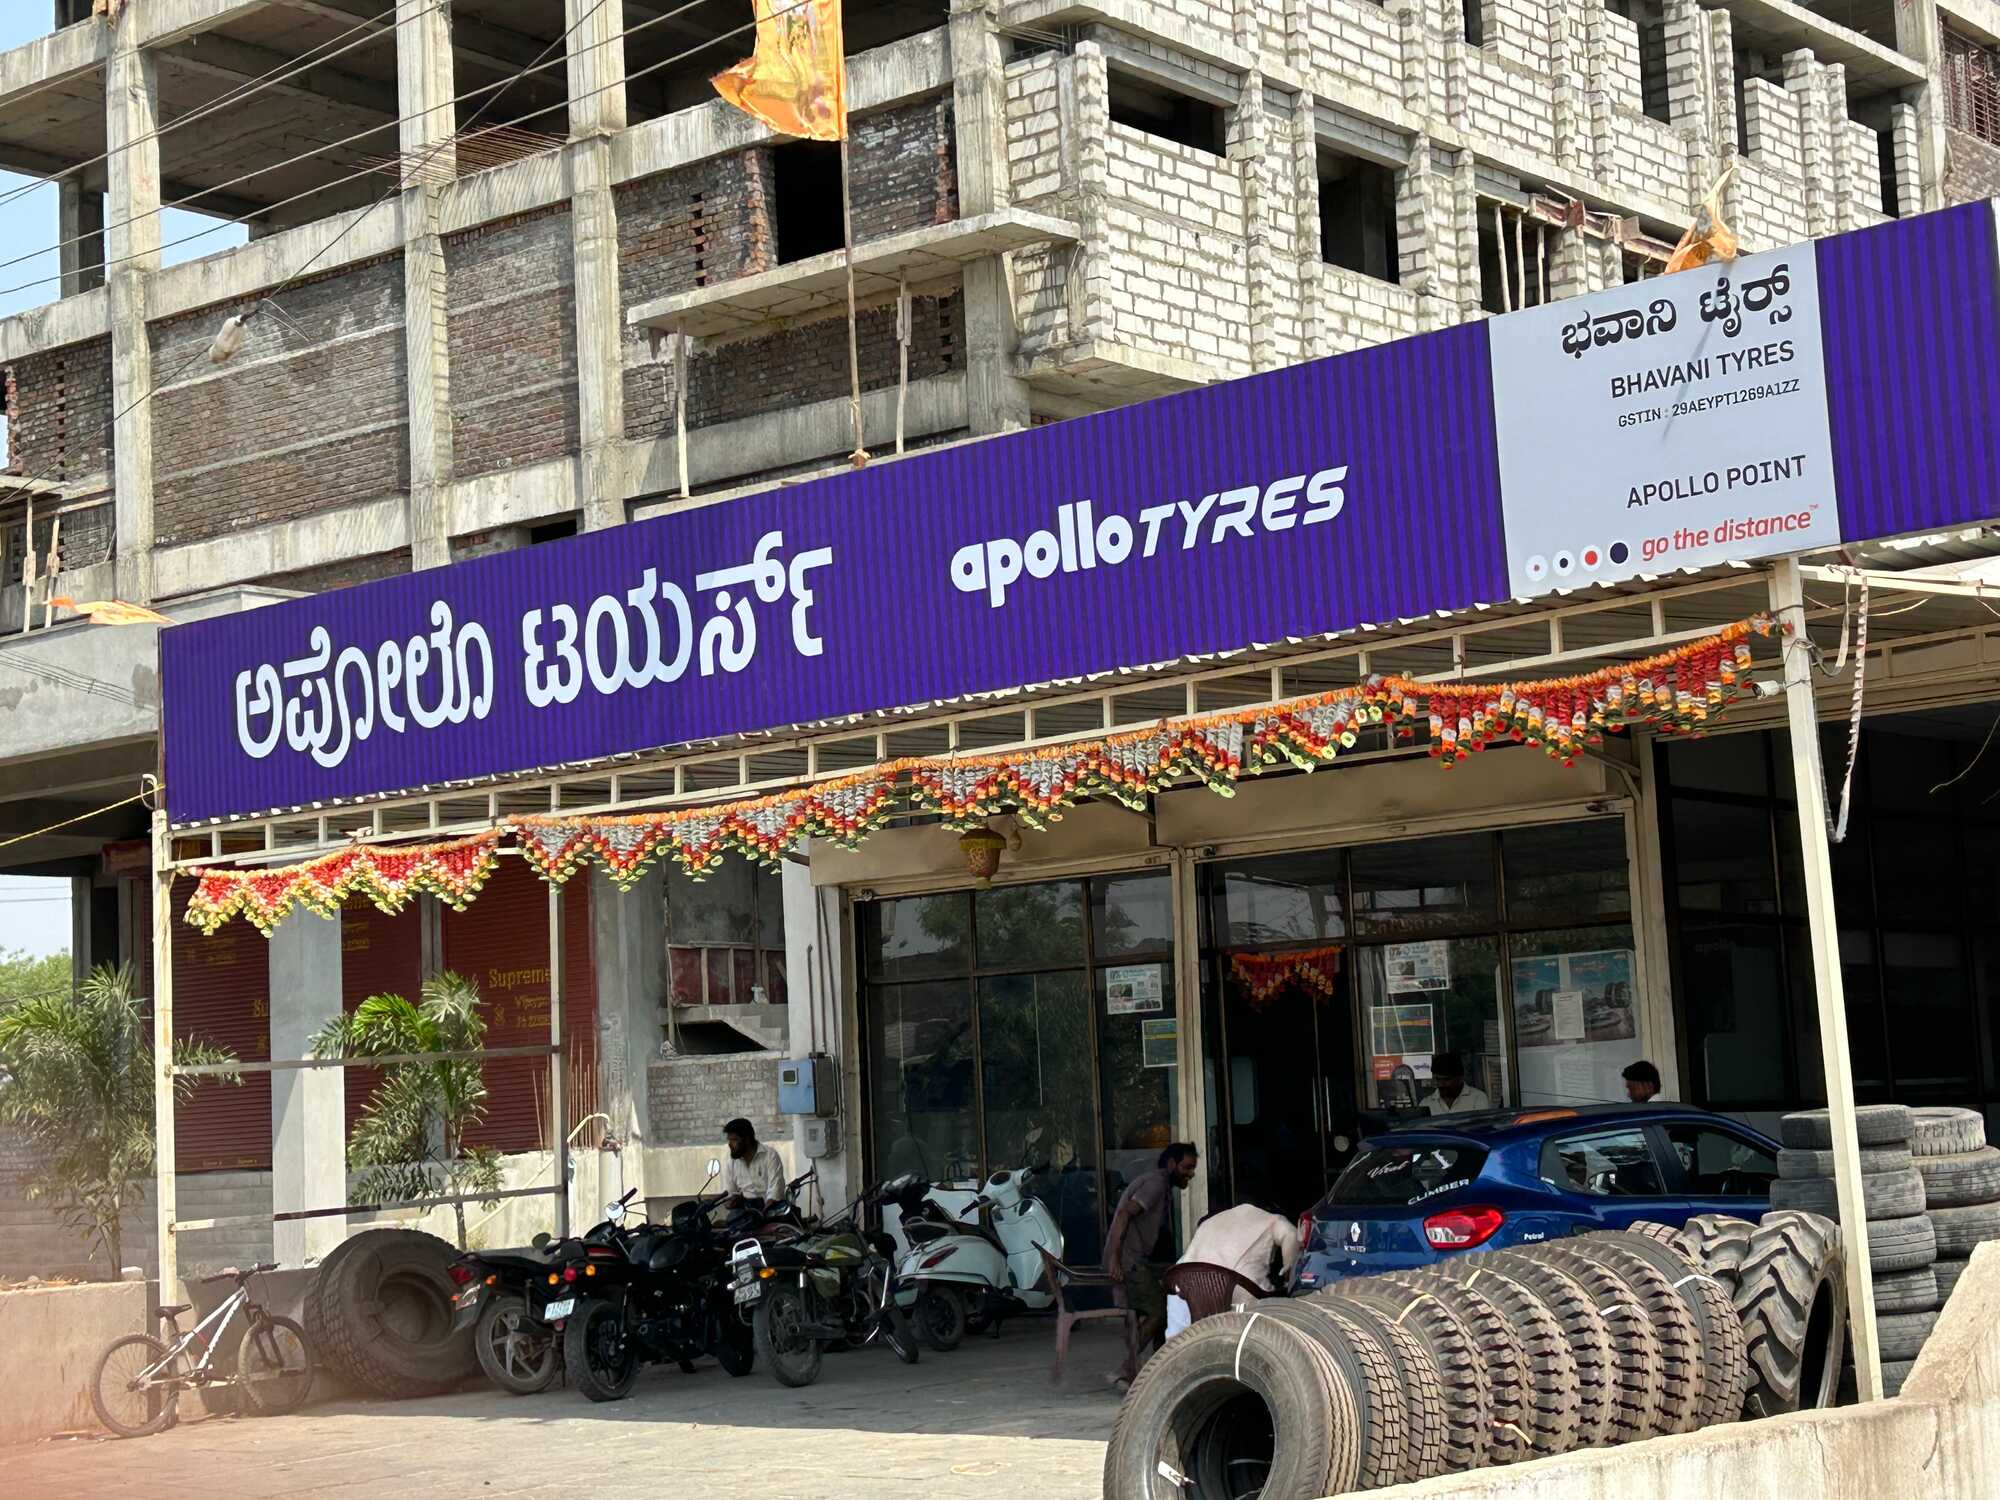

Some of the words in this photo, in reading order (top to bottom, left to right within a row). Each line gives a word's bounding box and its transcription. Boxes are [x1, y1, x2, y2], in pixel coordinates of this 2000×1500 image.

[1561, 299, 1677, 359] ಭವಾನಿ
[1611, 358, 1710, 399] BHAVANI
[1716, 340, 1795, 375] TYRES
[1618, 407, 1661, 428] GSTIN
[1671, 378, 1801, 418] 29AEYPT1269A1ZZ
[1627, 471, 1719, 509] APOLLO
[1726, 454, 1806, 490] POINT
[950, 499, 1133, 608] apollo
[1138, 465, 1348, 558] TYRES
[1642, 537, 1668, 561] go
[1673, 528, 1709, 551] the
[1407, 1178, 1470, 1205] CLIMBER
